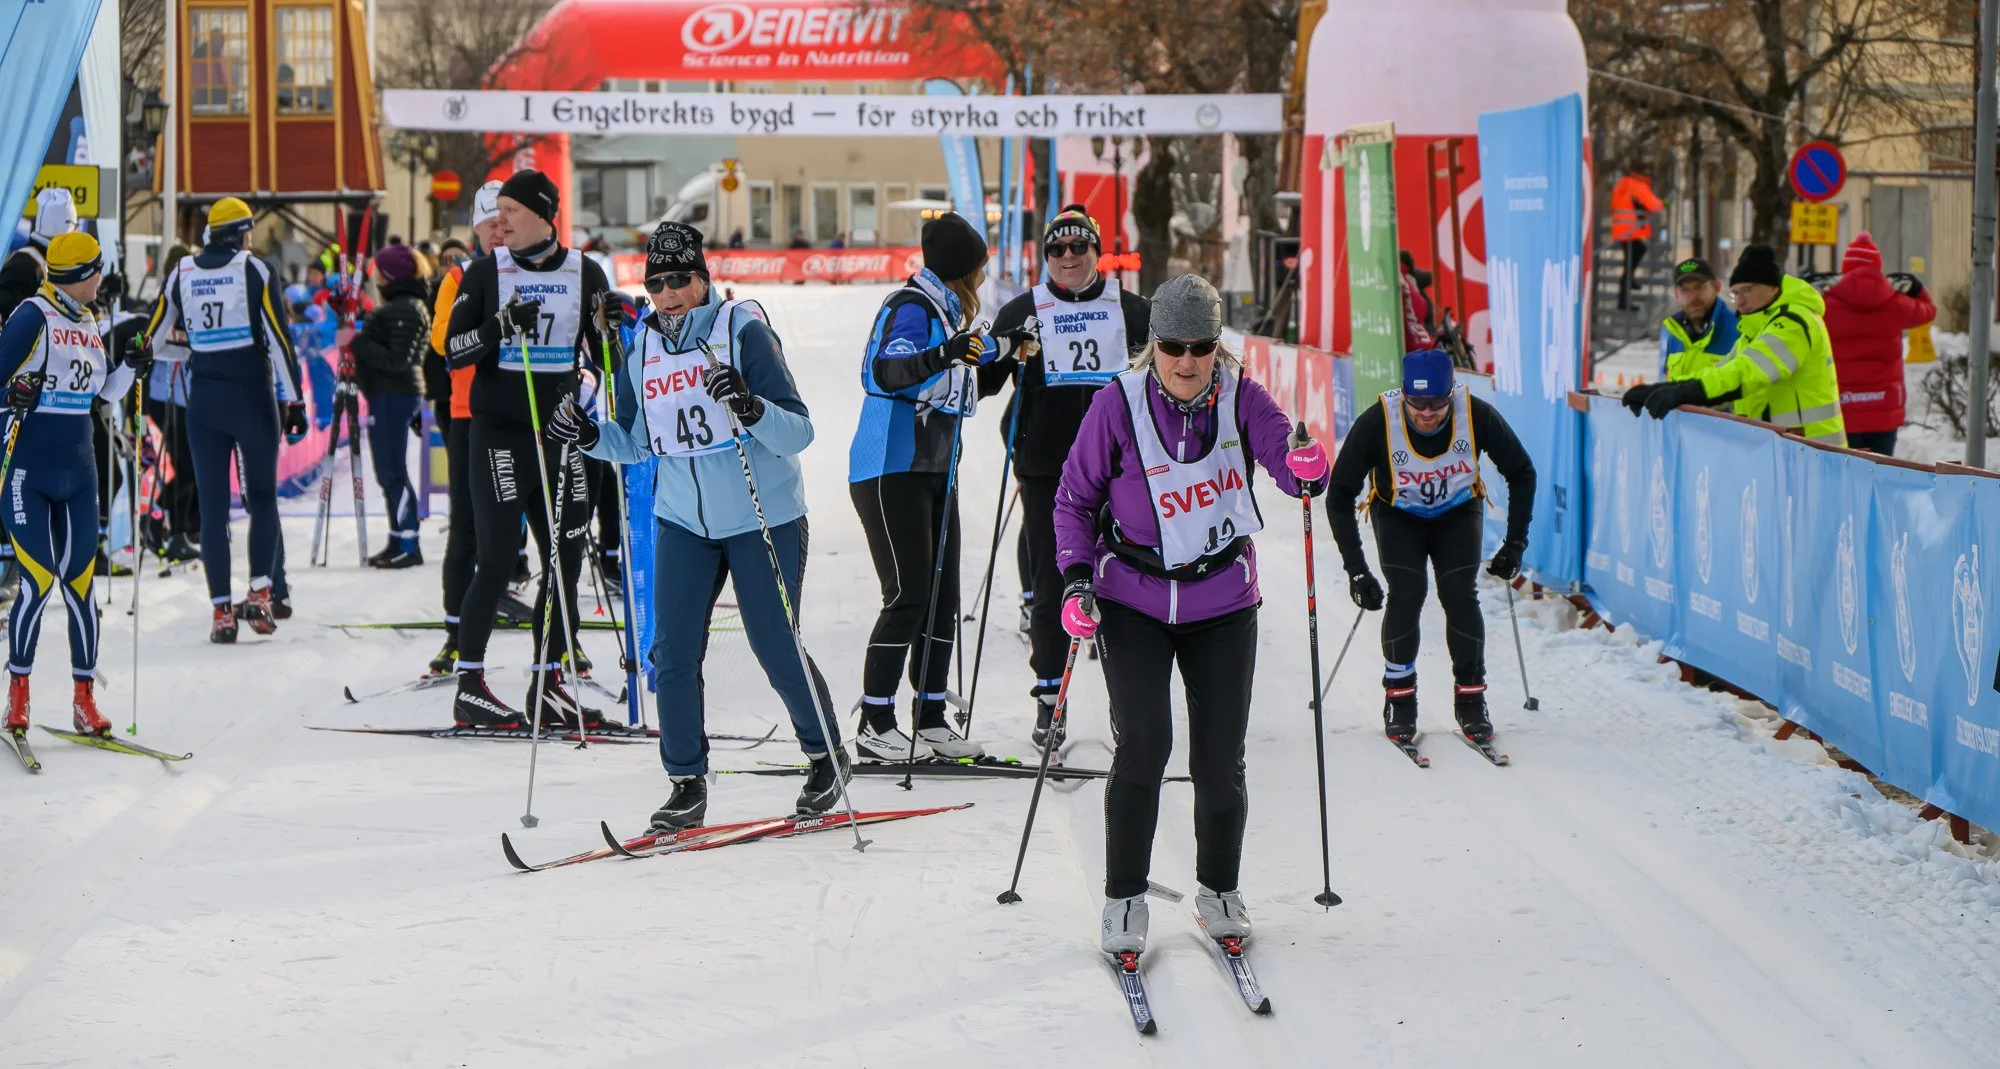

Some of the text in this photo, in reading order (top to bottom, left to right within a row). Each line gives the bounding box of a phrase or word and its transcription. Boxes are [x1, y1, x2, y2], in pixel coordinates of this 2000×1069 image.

[750, 7, 909, 46] ENERVIT
[682, 50, 910, 68] Science in Nutrition
[521, 96, 534, 122] I
[552, 96, 714, 131] Engelbrekts
[731, 101, 794, 133] bygd
[857, 102, 895, 127] för
[911, 103, 998, 132] styrka
[1015, 103, 1058, 128] och
[1074, 103, 1146, 128] frihet
[201, 301, 224, 329] 37
[1053, 311, 1109, 324] BARNCANCER
[1055, 322, 1087, 335] FONDEN
[1069, 338, 1102, 372] 23
[1048, 359, 1059, 372] 1
[46, 374, 58, 390] 3
[69, 359, 93, 392] 38
[947, 390, 959, 408] 2
[677, 404, 713, 450] 43
[654, 436, 667, 455] 1
[1421, 479, 1448, 505] 94
[863, 739, 905, 752] FISCHER
[793, 817, 824, 831] ATOMIC
[655, 833, 677, 846] ATOMIC
